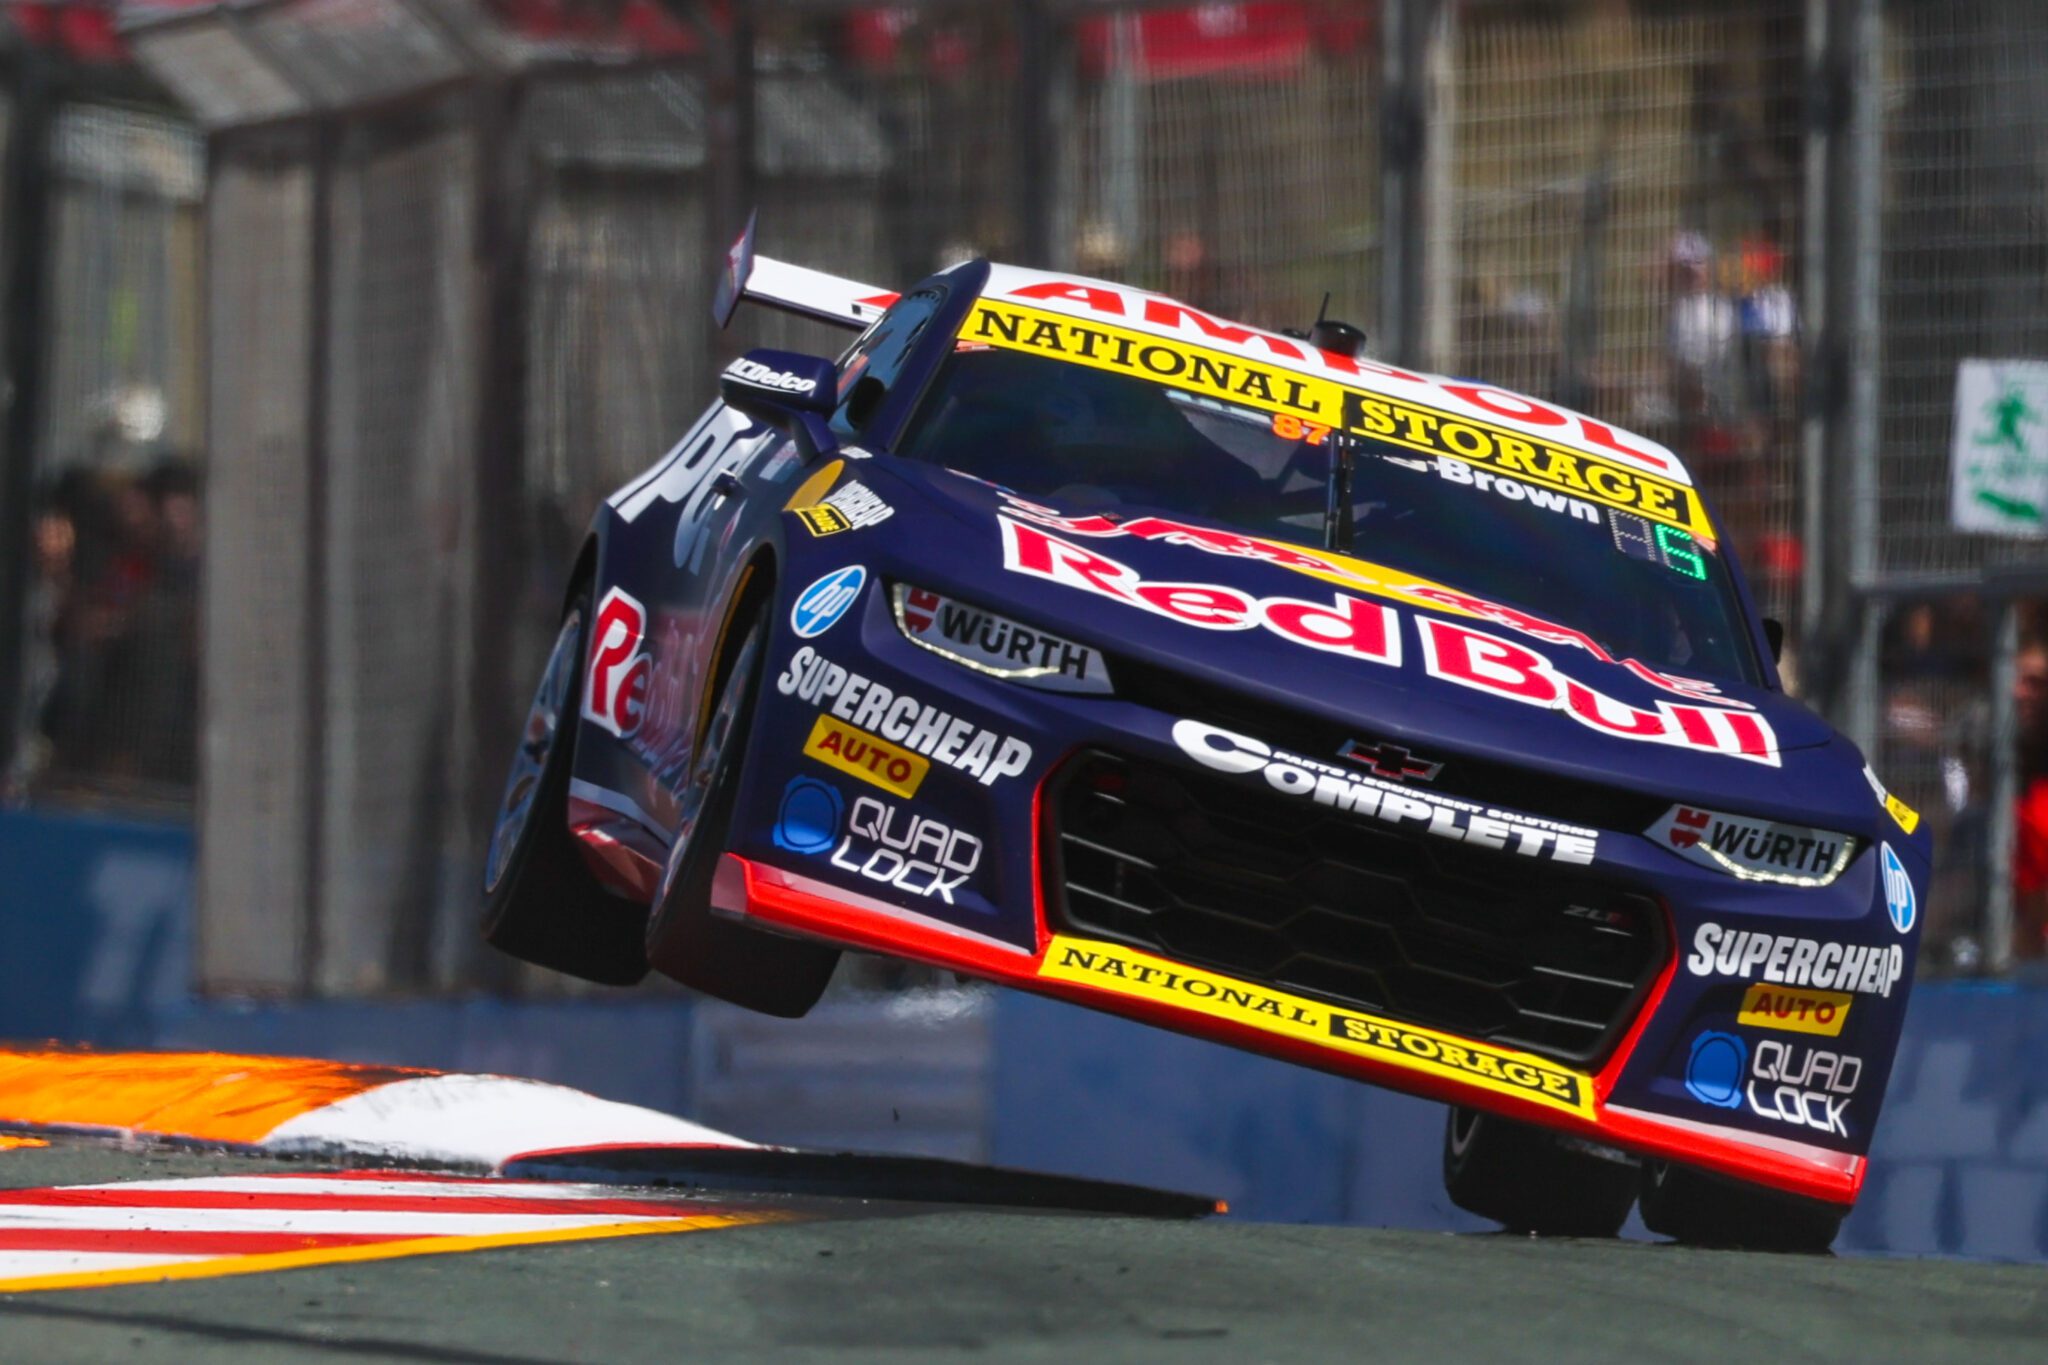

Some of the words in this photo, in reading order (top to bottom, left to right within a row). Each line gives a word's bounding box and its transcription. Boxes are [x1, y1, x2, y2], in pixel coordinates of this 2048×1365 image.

[975, 309, 1321, 414] NATIONAL
[1360, 398, 1677, 520] STORAGE
[1272, 413, 1332, 446] 87
[1437, 454, 1600, 525] Brown
[797, 566, 859, 636] hp
[997, 514, 1402, 667] Red
[1414, 615, 1781, 768] Bull
[777, 646, 1033, 786] SUPERCHEAP
[817, 730, 912, 783] AUTO
[1171, 719, 1597, 865] COMPLETE
[1273, 751, 1346, 777] PARTS
[1362, 776, 1484, 815] EQUIPMENT
[1486, 809, 1599, 838] SOLUTIONS
[831, 836, 969, 905] LOCK
[850, 796, 983, 874] QUAD
[1687, 922, 1904, 998] SUPERCHEAP
[1059, 947, 1319, 1027] NATIONAL
[1344, 1018, 1573, 1100] STORAGE
[1750, 992, 1837, 1025] AUTO
[1752, 1040, 1862, 1094] QUAD
[1746, 1079, 1852, 1138] LOCK
